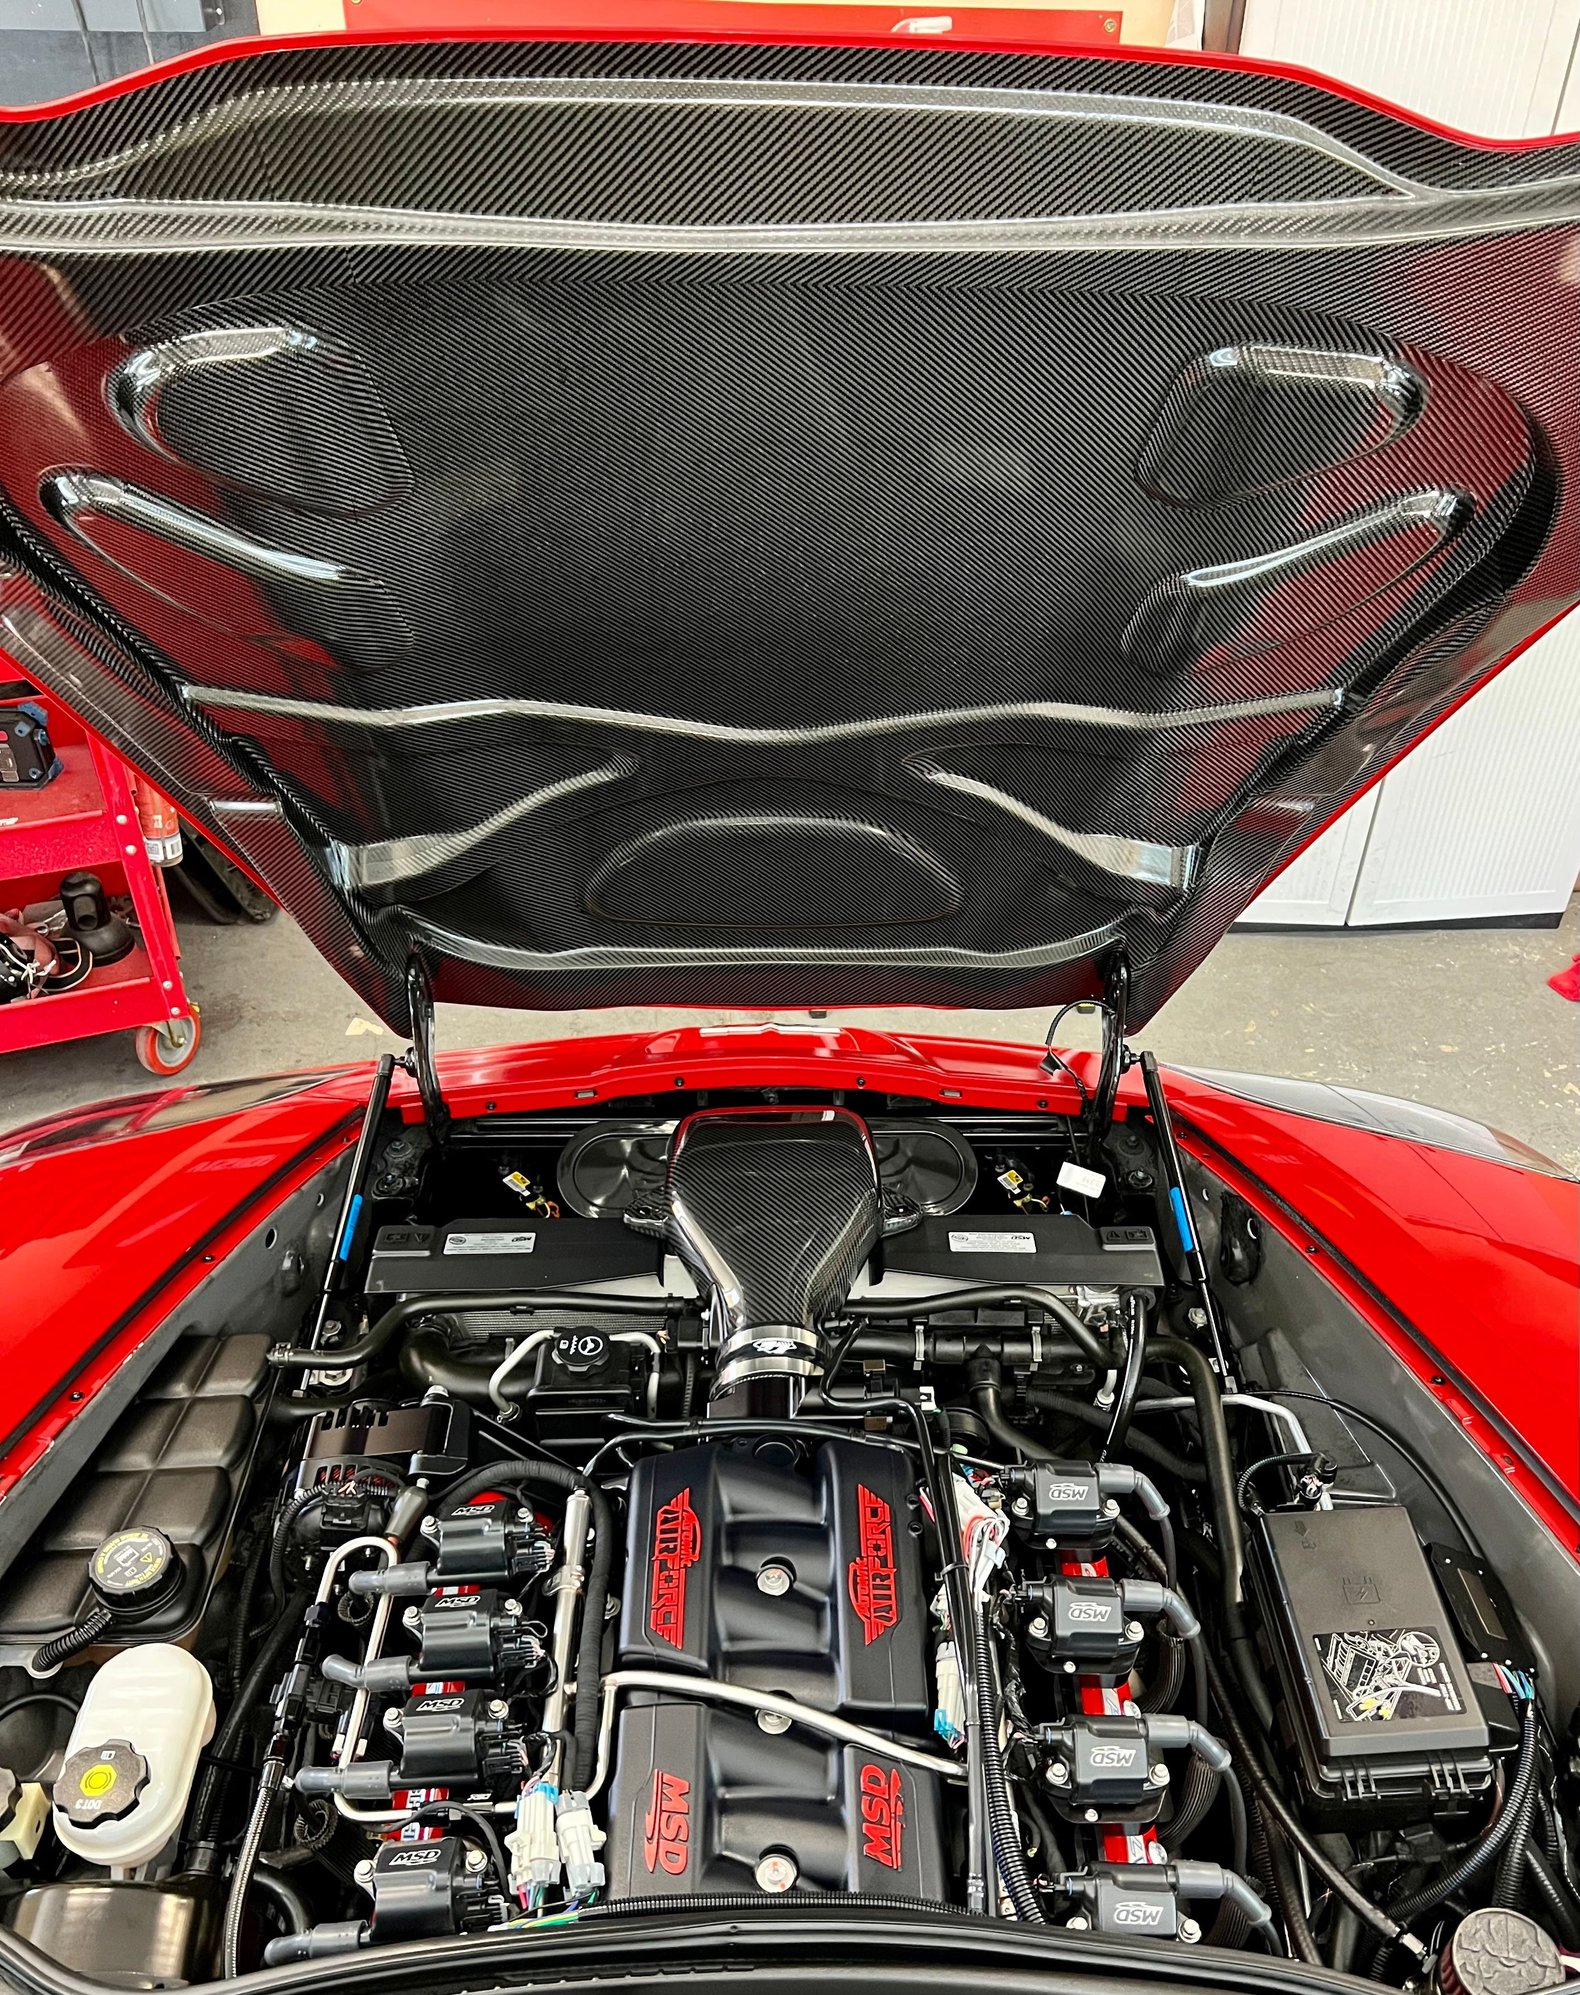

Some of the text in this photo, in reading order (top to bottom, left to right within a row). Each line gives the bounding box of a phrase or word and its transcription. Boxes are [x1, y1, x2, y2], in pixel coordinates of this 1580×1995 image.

[1049, 1485, 1088, 1500] MSD
[1069, 1605, 1111, 1621] MSD
[416, 1698, 465, 1712] MSD
[1091, 1749, 1136, 1766] MSD
[658, 1773, 691, 1875] MSD
[860, 1764, 895, 1869] MSD
[389, 1850, 442, 1866] MSD
[1114, 1906, 1163, 1925] MSD
